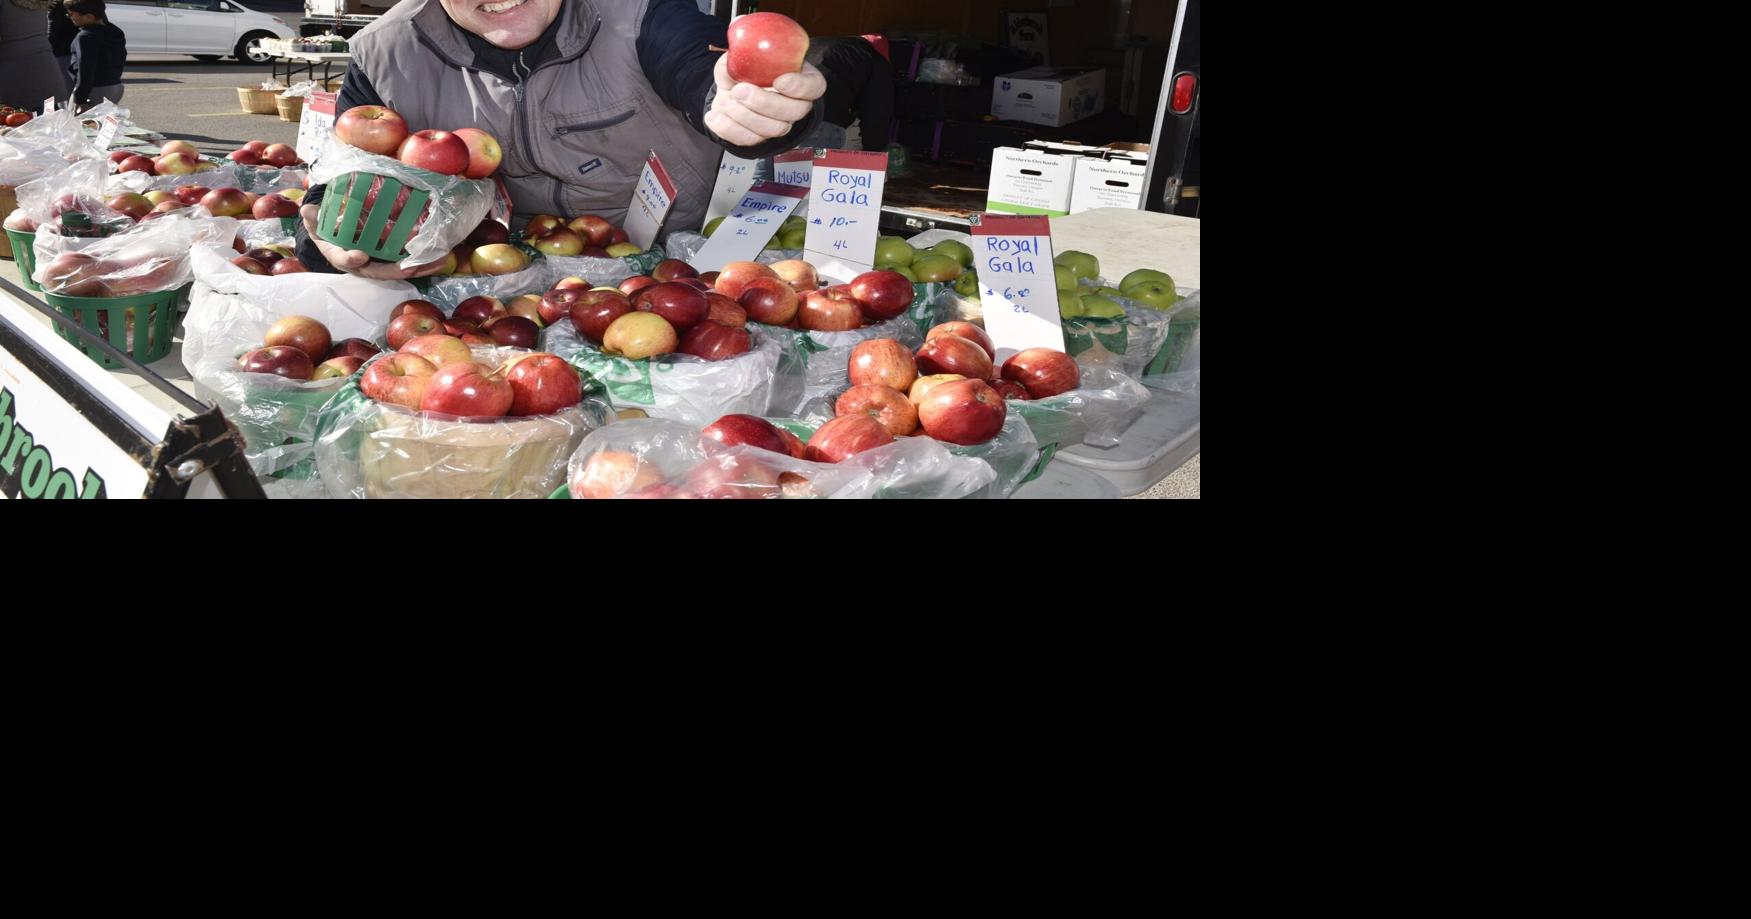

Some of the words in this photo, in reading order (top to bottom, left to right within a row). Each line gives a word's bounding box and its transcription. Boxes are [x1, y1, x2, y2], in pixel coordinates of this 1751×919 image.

[777, 169, 810, 185] Mutsu
[828, 170, 872, 189] Royal
[1118, 169, 1145, 177] Orchard
[644, 170, 666, 208] Empire
[821, 188, 868, 206] Gala
[741, 197, 787, 213] Empire
[986, 236, 1038, 256] Royal
[988, 256, 1035, 274] Gala
